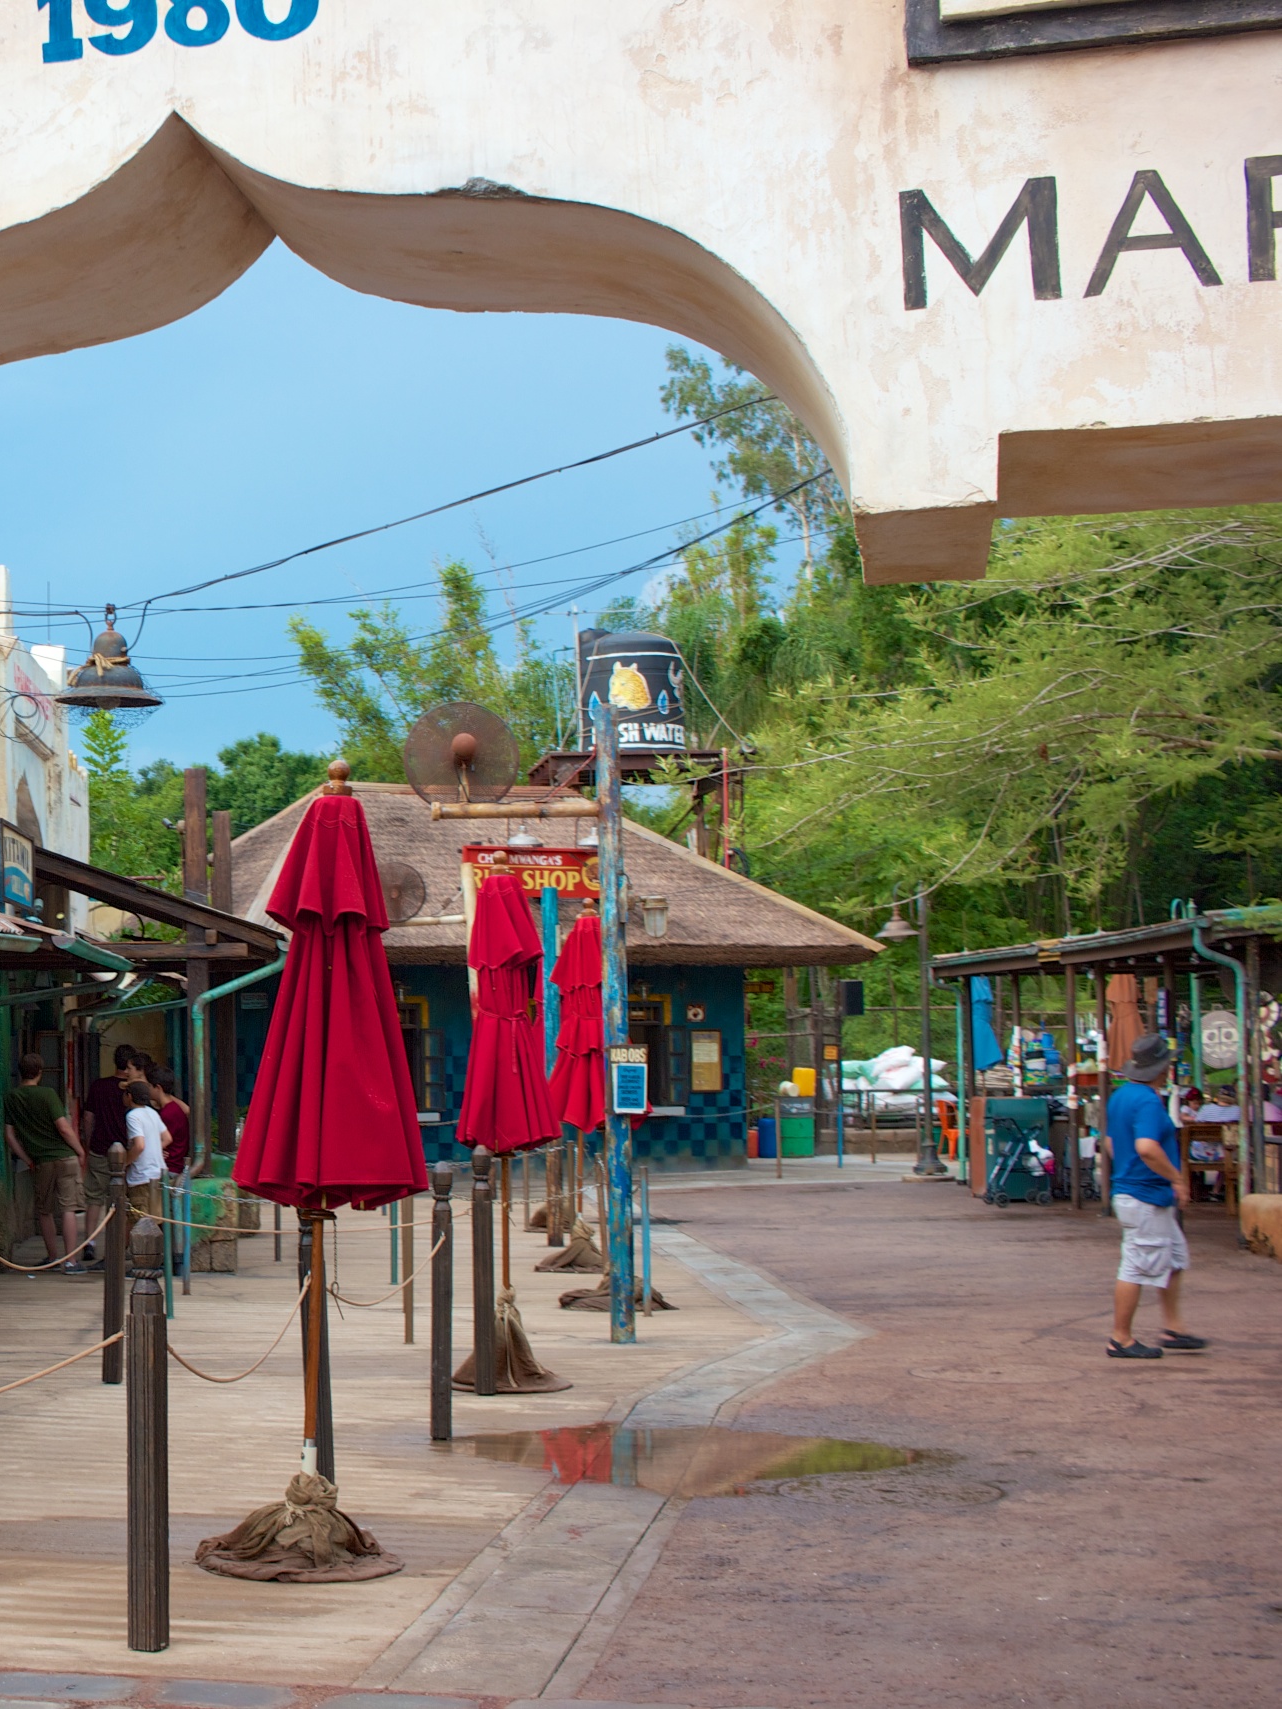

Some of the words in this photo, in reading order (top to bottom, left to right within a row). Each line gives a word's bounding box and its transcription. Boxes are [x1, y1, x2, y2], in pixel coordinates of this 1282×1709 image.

[509, 854, 563, 866] MWANGA'S
[522, 870, 581, 892] SHOP
[610, 1047, 647, 1063] KABOBS
